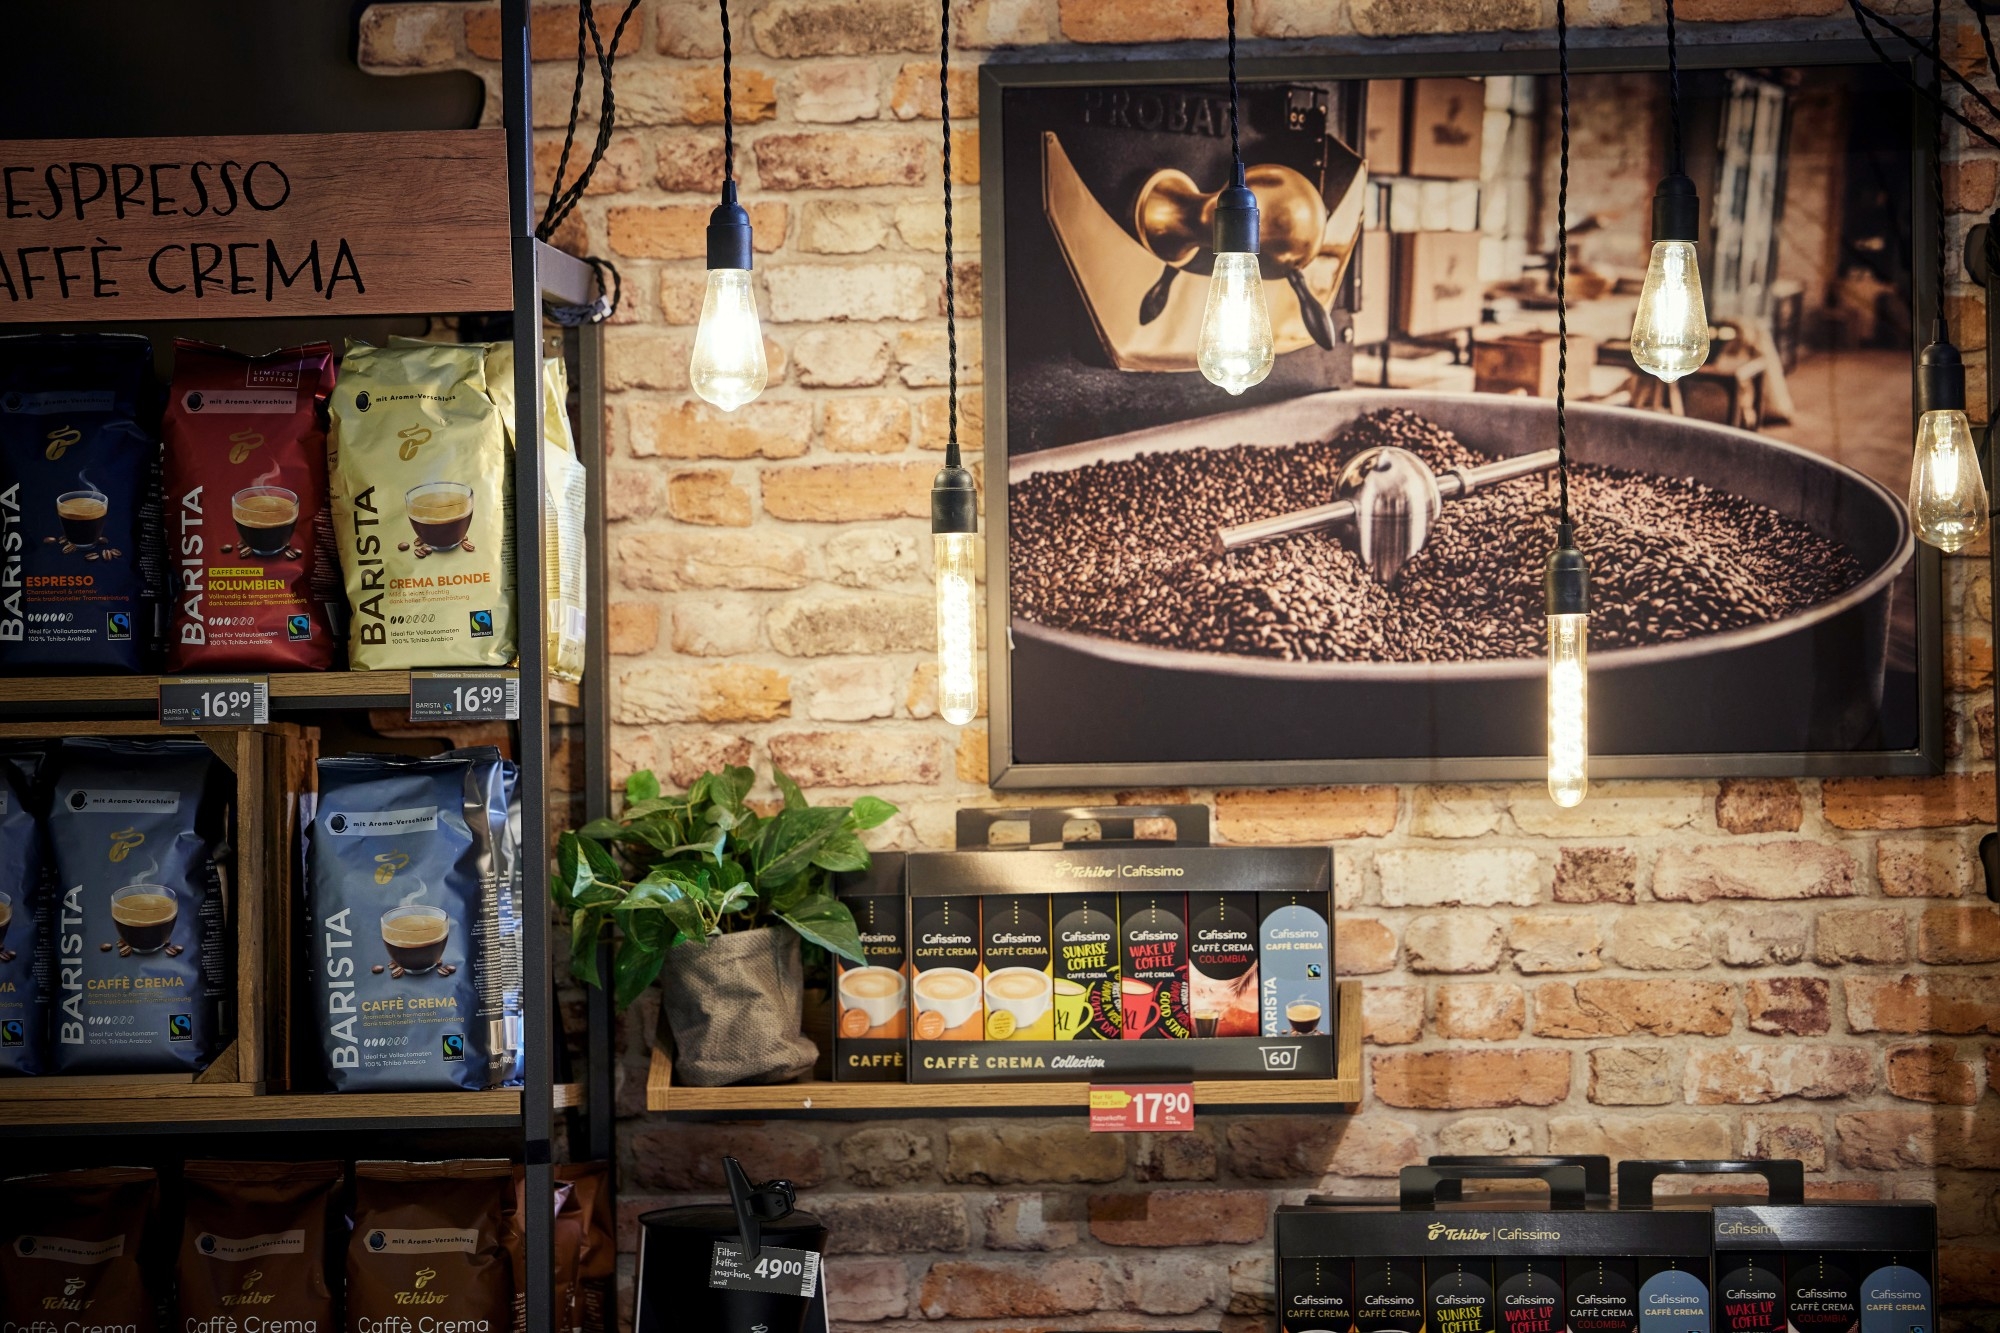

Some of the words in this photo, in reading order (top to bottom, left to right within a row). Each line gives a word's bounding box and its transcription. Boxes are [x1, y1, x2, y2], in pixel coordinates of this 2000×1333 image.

[2, 160, 290, 221] ESPRESSO
[148, 238, 365, 302] CREMA
[0, 482, 24, 642] BARISTA
[181, 485, 205, 645] BARISTA
[354, 486, 387, 645] BARISTA
[211, 568, 234, 576] CAFFÈ
[25, 575, 94, 587] ESPRESSO
[208, 579, 285, 591] KOLUMBIEN
[389, 577, 434, 589] CREMA
[437, 572, 490, 586] BLONDE
[368, 816, 434, 827] Aroma-Verschluss
[1071, 866, 1116, 878] Tchibo
[1122, 865, 1185, 877] Cafissimo
[922, 934, 971, 944] Cafissimo
[992, 933, 1041, 944] Cafissimo
[1061, 930, 1111, 942] Cafissimo
[1129, 929, 1179, 942] Cafissimo
[1198, 929, 1247, 941] Cafissimo
[1269, 928, 1319, 940] Cafissimo
[916, 946, 944, 957] CAFFÈ
[946, 947, 978, 957] CREMA
[986, 946, 1014, 956] CAFFÈ
[1015, 947, 1048, 956] CREMA
[1062, 942, 1109, 959] SUNRISE
[1129, 944, 1160, 958] WAKE
[1162, 942, 1177, 954] UP
[1191, 942, 1220, 952] CAFFÈ
[1222, 942, 1254, 952] CREMA
[1265, 941, 1292, 951] CAFFÈ
[1293, 942, 1323, 951] CREMA
[61, 884, 85, 1045] BARISTA
[1067, 955, 1108, 971] COFFEE
[1135, 955, 1175, 971] COFFEE
[1199, 955, 1247, 964] COLOMBIA
[1067, 971, 1086, 979] CAFFÈ
[1134, 971, 1154, 979] CAFFÈ
[87, 976, 130, 990] CAFFÈ
[134, 977, 184, 988] CREMA
[324, 907, 360, 1069] BARISTA
[361, 996, 404, 1012] CAFFÈ
[408, 996, 458, 1010] CREMA
[1160, 991, 1172, 1018] GOOD
[1100, 1021, 1119, 1037] DAY
[848, 1052, 904, 1068] CAFFÈ
[923, 1053, 979, 1069] CAFFÈ
[986, 1056, 1046, 1069] CREMA
[1051, 1055, 1105, 1068] Collection
[1269, 1051, 1291, 1066] 60
[1445, 1228, 1490, 1241] Tchibo
[1498, 1228, 1561, 1240] Cafissimo
[1718, 1222, 1781, 1235] Cafissimo
[393, 1291, 449, 1305] Tchibo
[1435, 1294, 1485, 1305] Cafissimo
[1505, 1294, 1555, 1305] Cafissimo
[1576, 1294, 1626, 1305] Cafissimo
[1649, 1293, 1699, 1304] Cafissimo
[1726, 1290, 1776, 1300] Cafissimo
[1796, 1288, 1847, 1299] Cafissimo
[1871, 1289, 1921, 1299] Cafissimo
[221, 1293, 276, 1307] Tchibo
[1293, 1295, 1343, 1305] Cafissimo
[1364, 1295, 1414, 1305] Cafissimo
[1790, 1301, 1819, 1311] CAFFÈ
[1822, 1303, 1854, 1311] CREMA
[1358, 1307, 1387, 1318] CAFFÈ
[1389, 1309, 1421, 1318] CREMA
[1570, 1308, 1599, 1317] CAFFÈ
[1601, 1309, 1634, 1317] CREMA
[1645, 1306, 1672, 1316] CAFFÈ
[1673, 1308, 1704, 1316] CREMA
[1725, 1302, 1758, 1316] WAKE
[1760, 1301, 1775, 1314] UP
[1866, 1302, 1893, 1311] CAFFÈ
[1287, 1308, 1315, 1318] CAFFÈ
[1317, 1310, 1350, 1318] CREMA
[1437, 1306, 1483, 1322] SUNRISE
[1505, 1307, 1537, 1321] WAKE
[1539, 1306, 1553, 1319] UP
[1798, 1314, 1848, 1323] COLOMBIA
[186, 1316, 237, 1333] Caffè
[243, 1315, 318, 1333] Crema
[358, 1316, 412, 1333] Caffè
[418, 1316, 489, 1333] Crema
[1442, 1319, 1482, 1333] COFFEE
[1511, 1319, 1551, 1333] COFFEE
[1577, 1320, 1627, 1329] COLOMBIA
[1732, 1314, 1772, 1329] COFFEE
